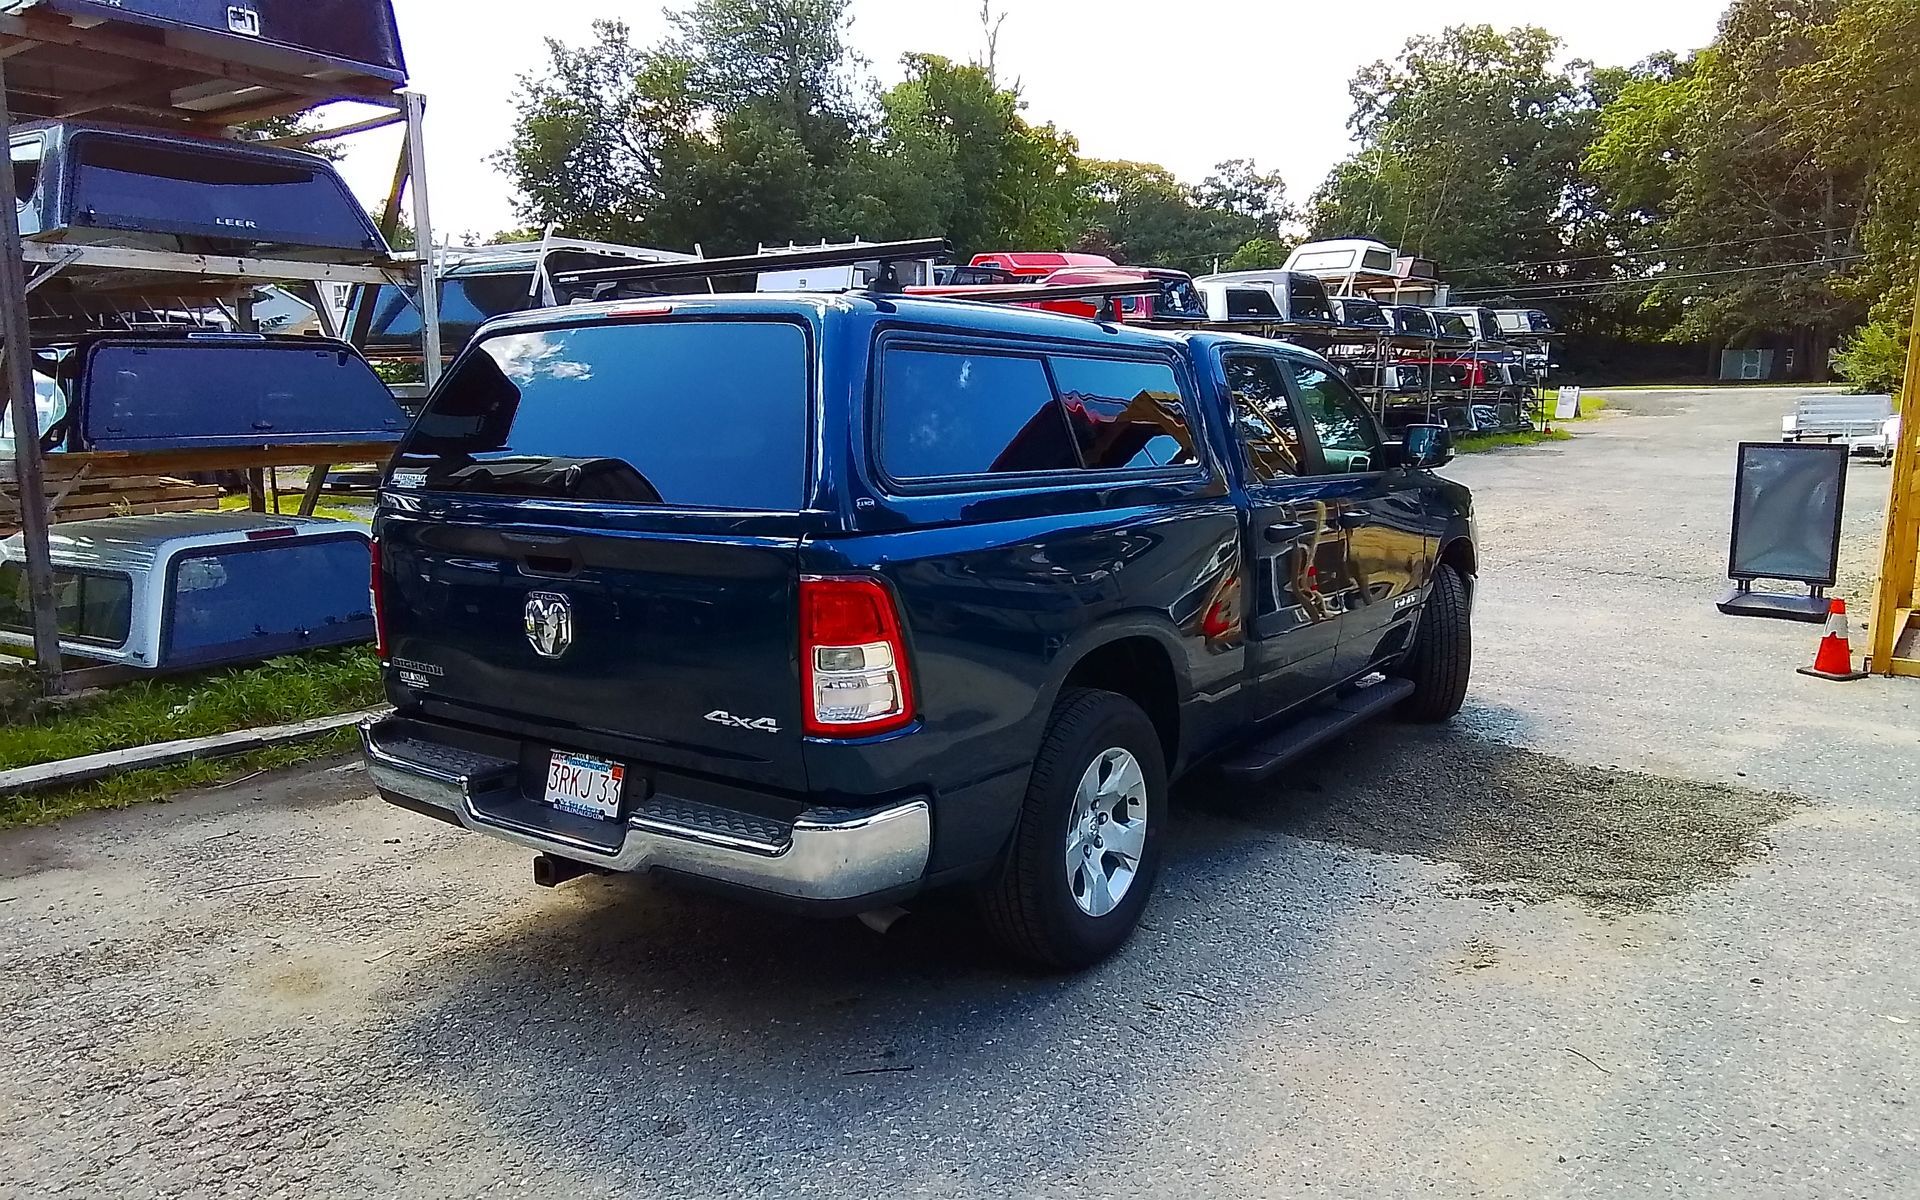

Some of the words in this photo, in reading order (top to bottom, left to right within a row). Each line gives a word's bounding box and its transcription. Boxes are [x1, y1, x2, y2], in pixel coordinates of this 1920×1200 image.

[215, 217, 257, 229] LEER
[548, 762, 594, 798] 3RKJ
[597, 774, 621, 806] 33
